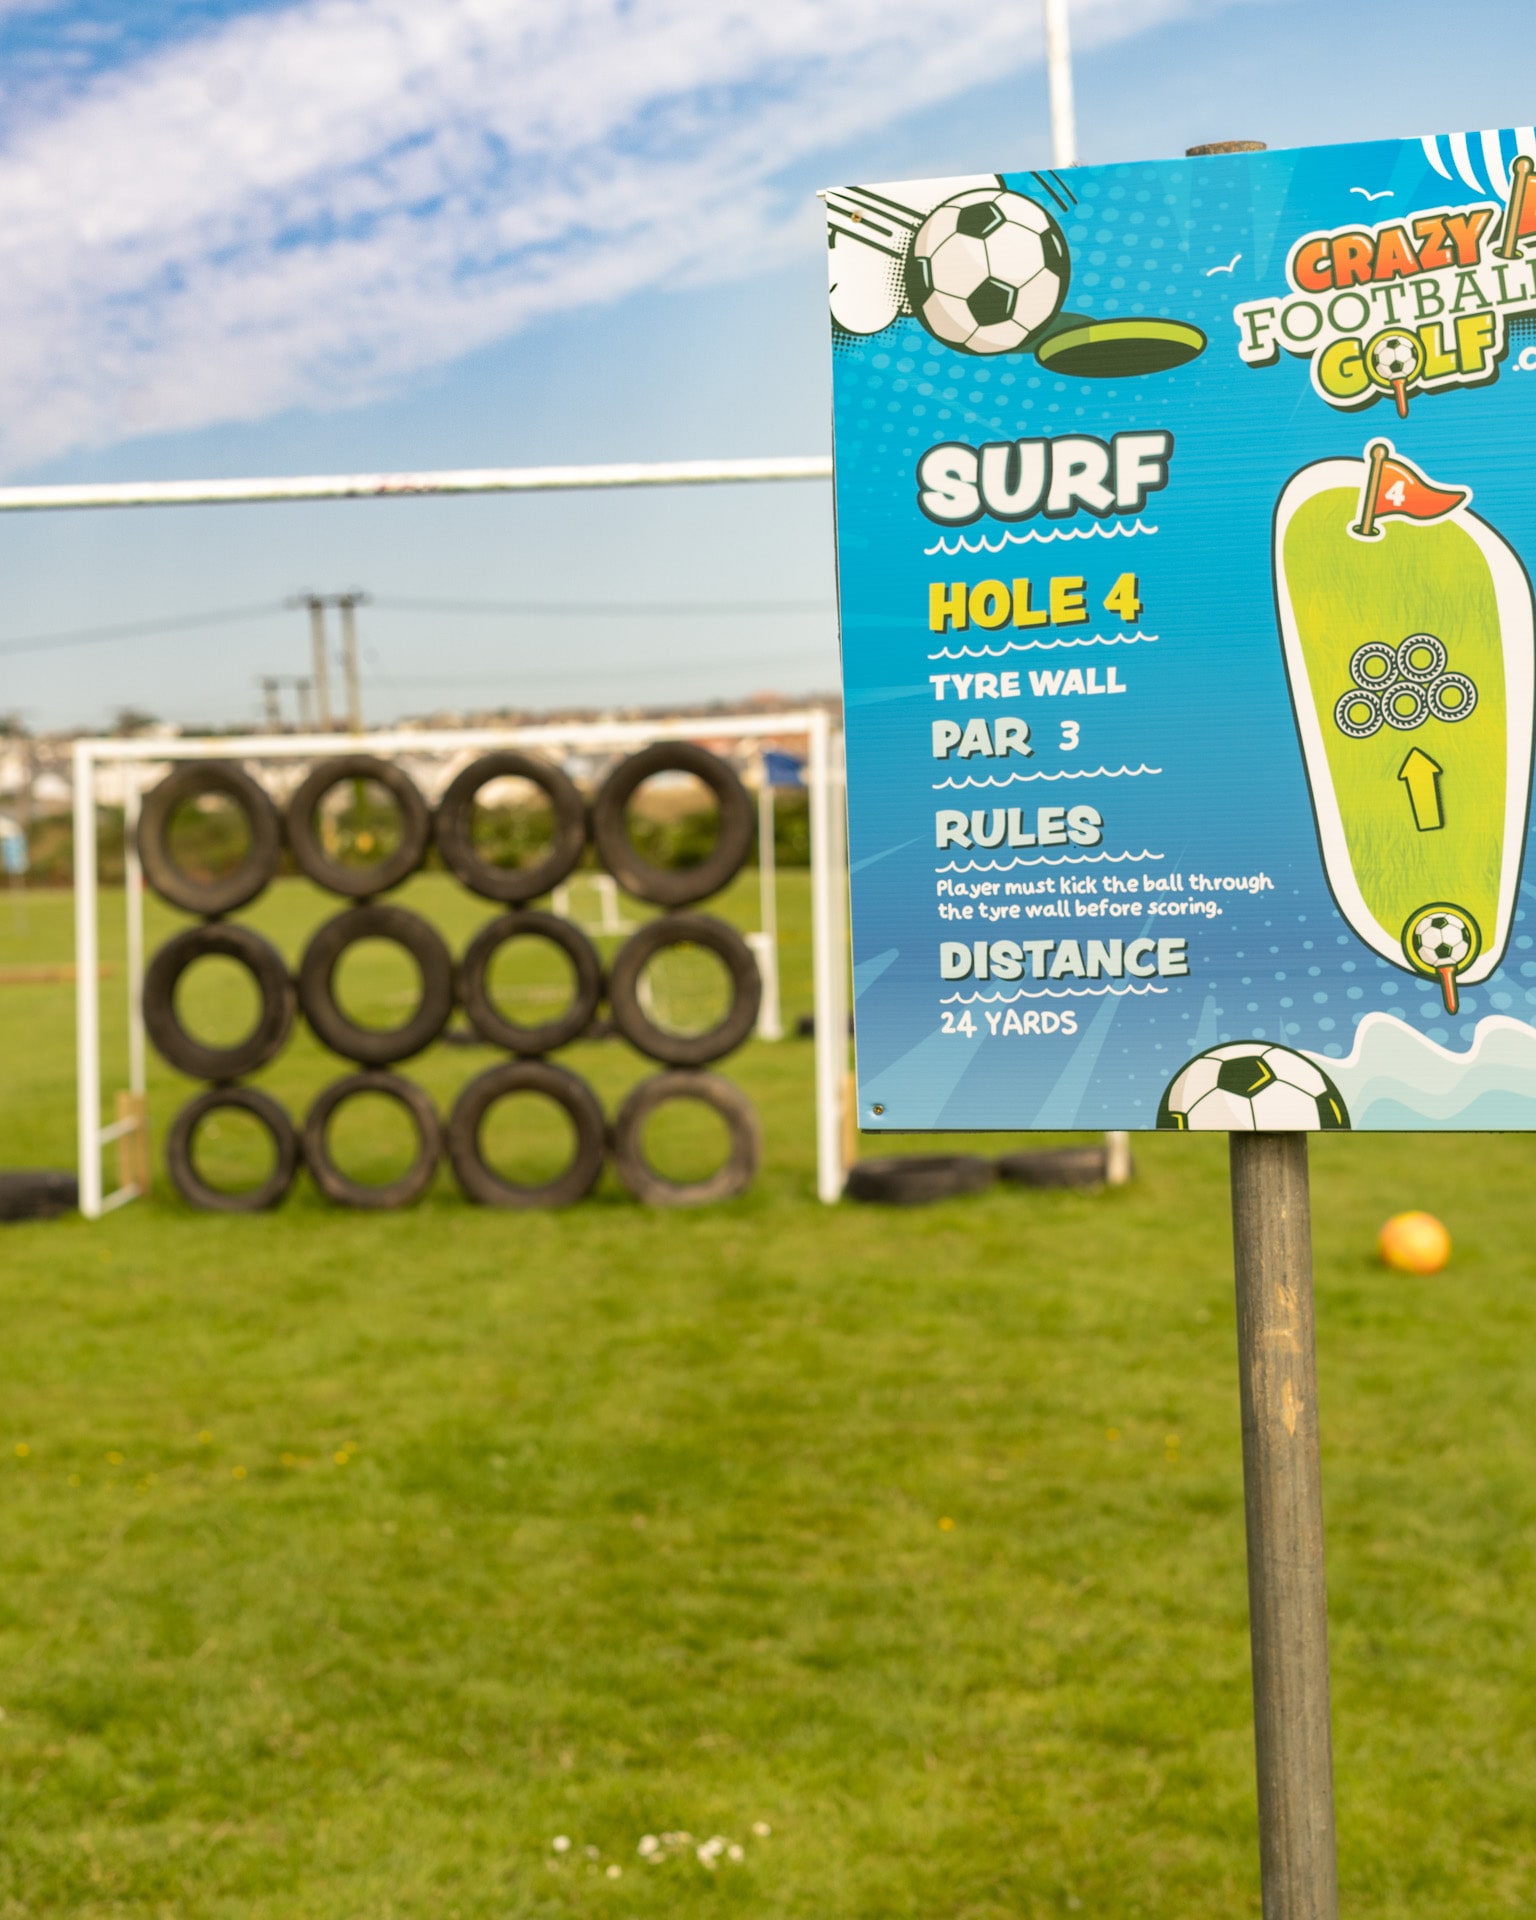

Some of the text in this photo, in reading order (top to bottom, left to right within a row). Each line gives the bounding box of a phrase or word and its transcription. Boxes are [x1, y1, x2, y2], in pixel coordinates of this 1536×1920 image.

[1293, 209, 1493, 294] CRAZY
[1317, 313, 1496, 398] GOLF
[917, 430, 1174, 527] SURF
[1384, 480, 1406, 507] 4
[928, 572, 1144, 634] HOLE 4
[928, 666, 1128, 701] TYRE WALL
[931, 717, 1081, 759] PAR 3
[935, 805, 1104, 850] RULES
[936, 872, 1275, 899] Player must kick the ball through
[938, 896, 1223, 922] the tyre wall before scoring.
[939, 937, 1190, 982] DISTANCE
[940, 1008, 1079, 1038] 24 YARDS
